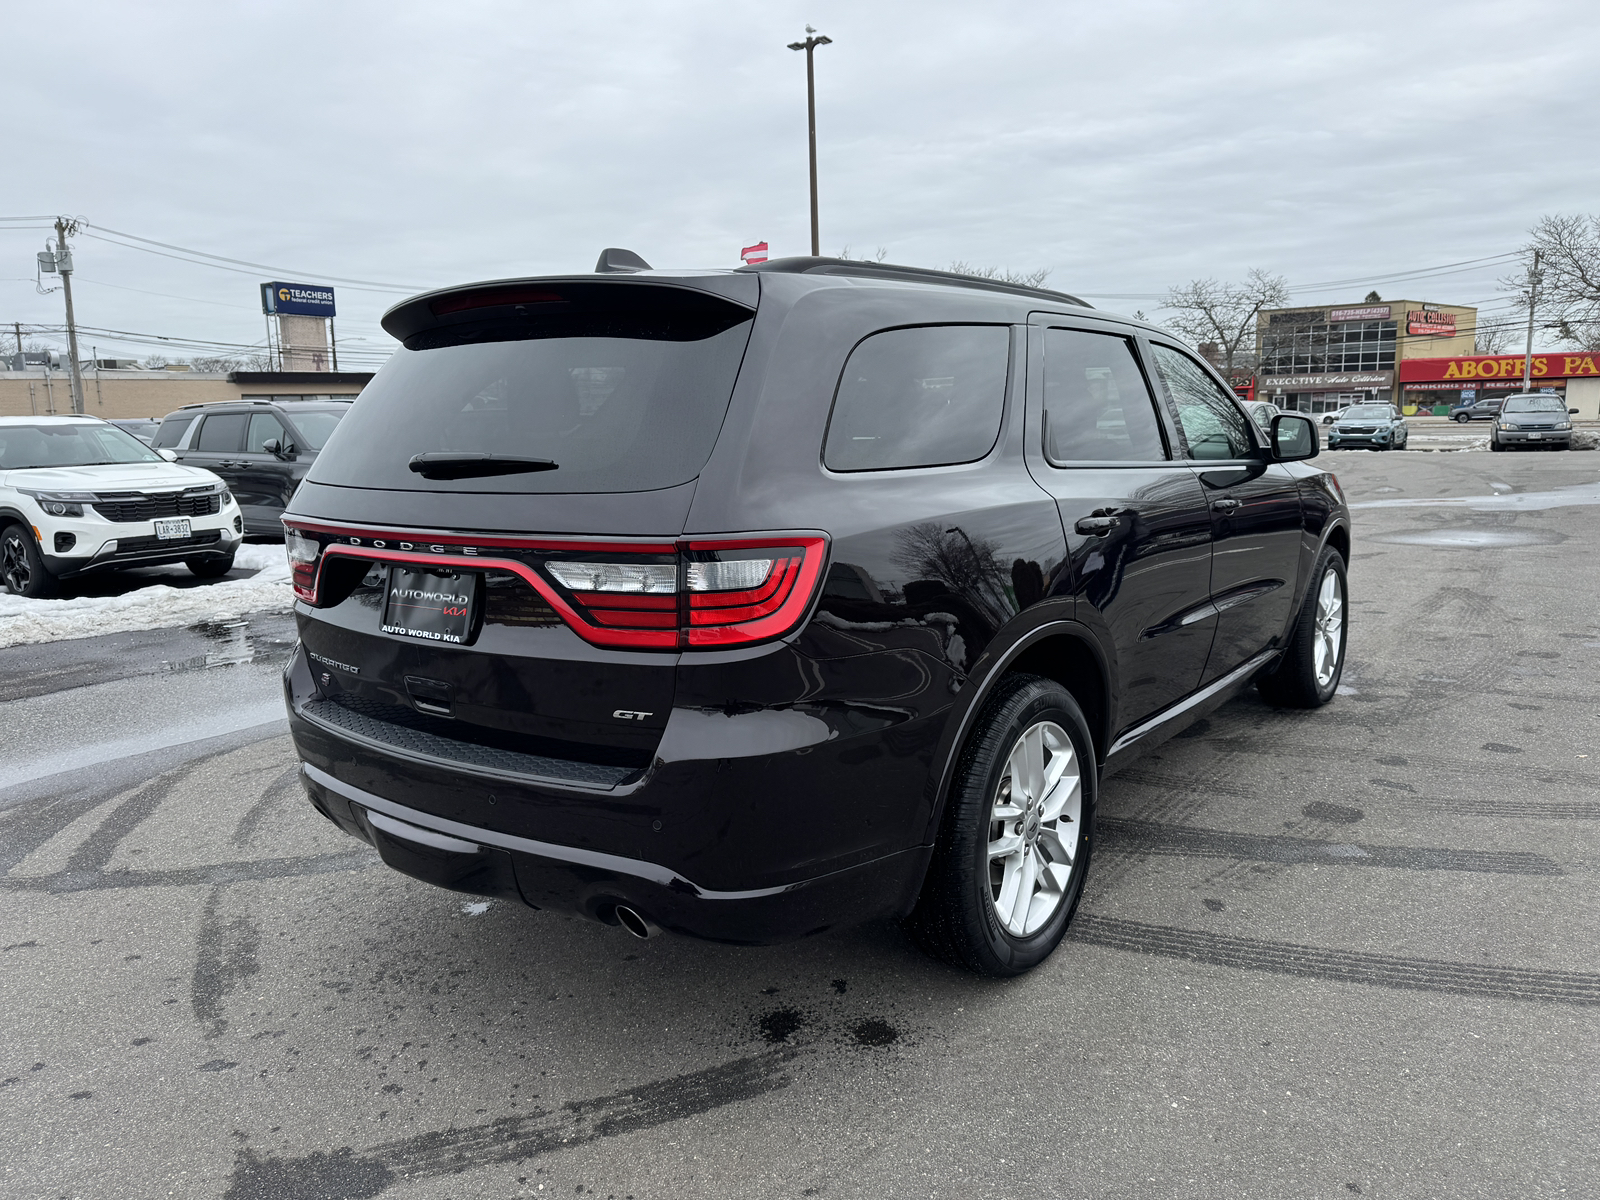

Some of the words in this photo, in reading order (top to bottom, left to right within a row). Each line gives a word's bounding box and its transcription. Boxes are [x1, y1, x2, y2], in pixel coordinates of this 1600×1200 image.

[290, 289, 333, 300] TEACHERS
[1562, 356, 1600, 375] PA
[1265, 376, 1322, 386] EXECUTIVE
[1324, 375, 1349, 384] Auto
[1351, 374, 1386, 383] Collision
[350, 536, 478, 555] DODGE
[390, 587, 468, 605] AUTOWORLD
[443, 606, 467, 616] KIA
[381, 625, 406, 635] AUTO
[408, 628, 441, 640] WORLD
[443, 634, 460, 643] KIA
[310, 652, 360, 675] DURANGO
[612, 709, 654, 721] GT
